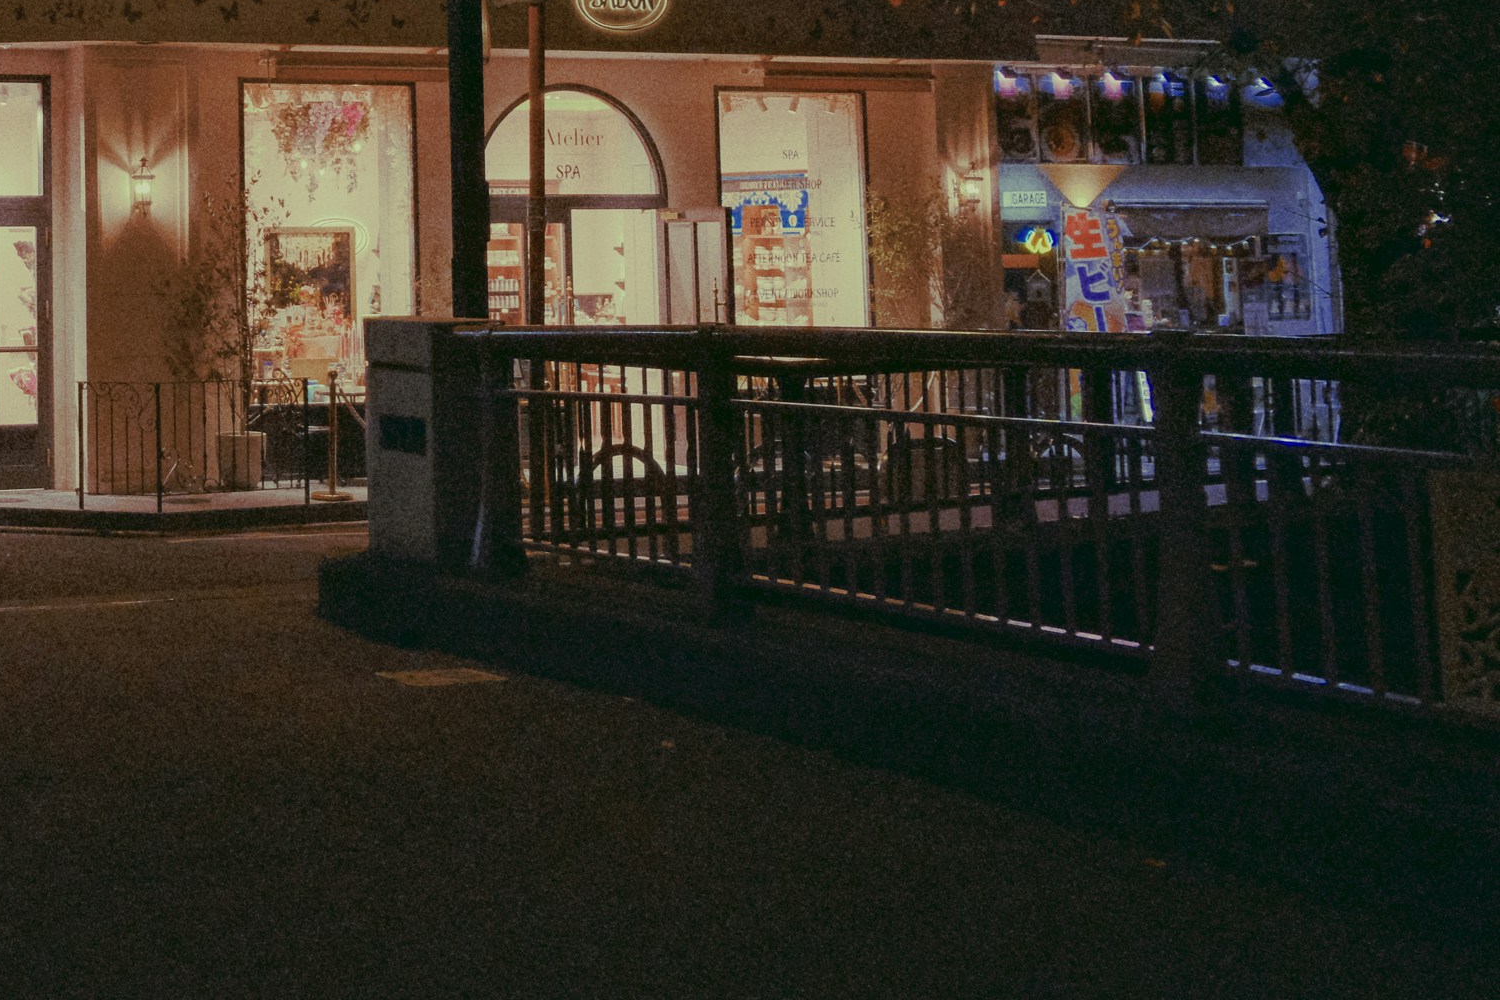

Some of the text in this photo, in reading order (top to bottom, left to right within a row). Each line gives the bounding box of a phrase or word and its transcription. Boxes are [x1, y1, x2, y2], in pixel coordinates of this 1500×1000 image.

[547, 128, 604, 146] Atelier
[782, 149, 799, 160] SPA
[556, 164, 581, 180] SPA
[799, 178, 822, 189] SHOP
[1012, 192, 1045, 205] GARAGE
[801, 252, 818, 263] TEA
